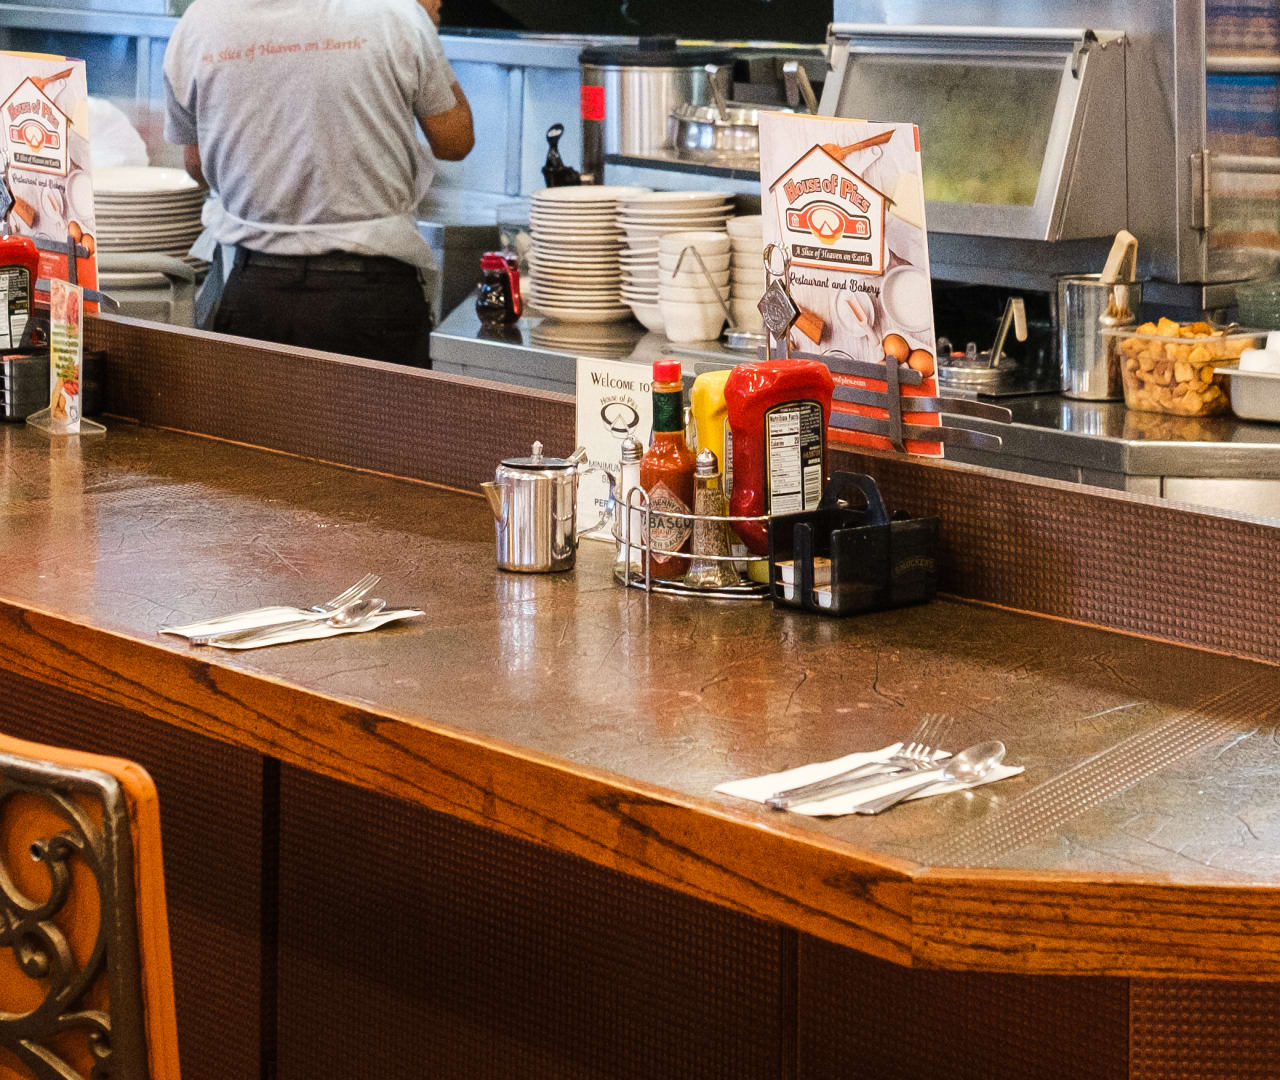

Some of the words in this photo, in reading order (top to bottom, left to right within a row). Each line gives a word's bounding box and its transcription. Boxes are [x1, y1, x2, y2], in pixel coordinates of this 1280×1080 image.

[822, 174, 839, 195] of
[795, 247, 800, 255] A
[801, 247, 814, 257] Slice
[814, 249, 821, 259] of
[821, 249, 843, 260] Heaven
[790, 272, 829, 288] Restaurant
[832, 280, 847, 290] and
[849, 279, 881, 298] Bakery
